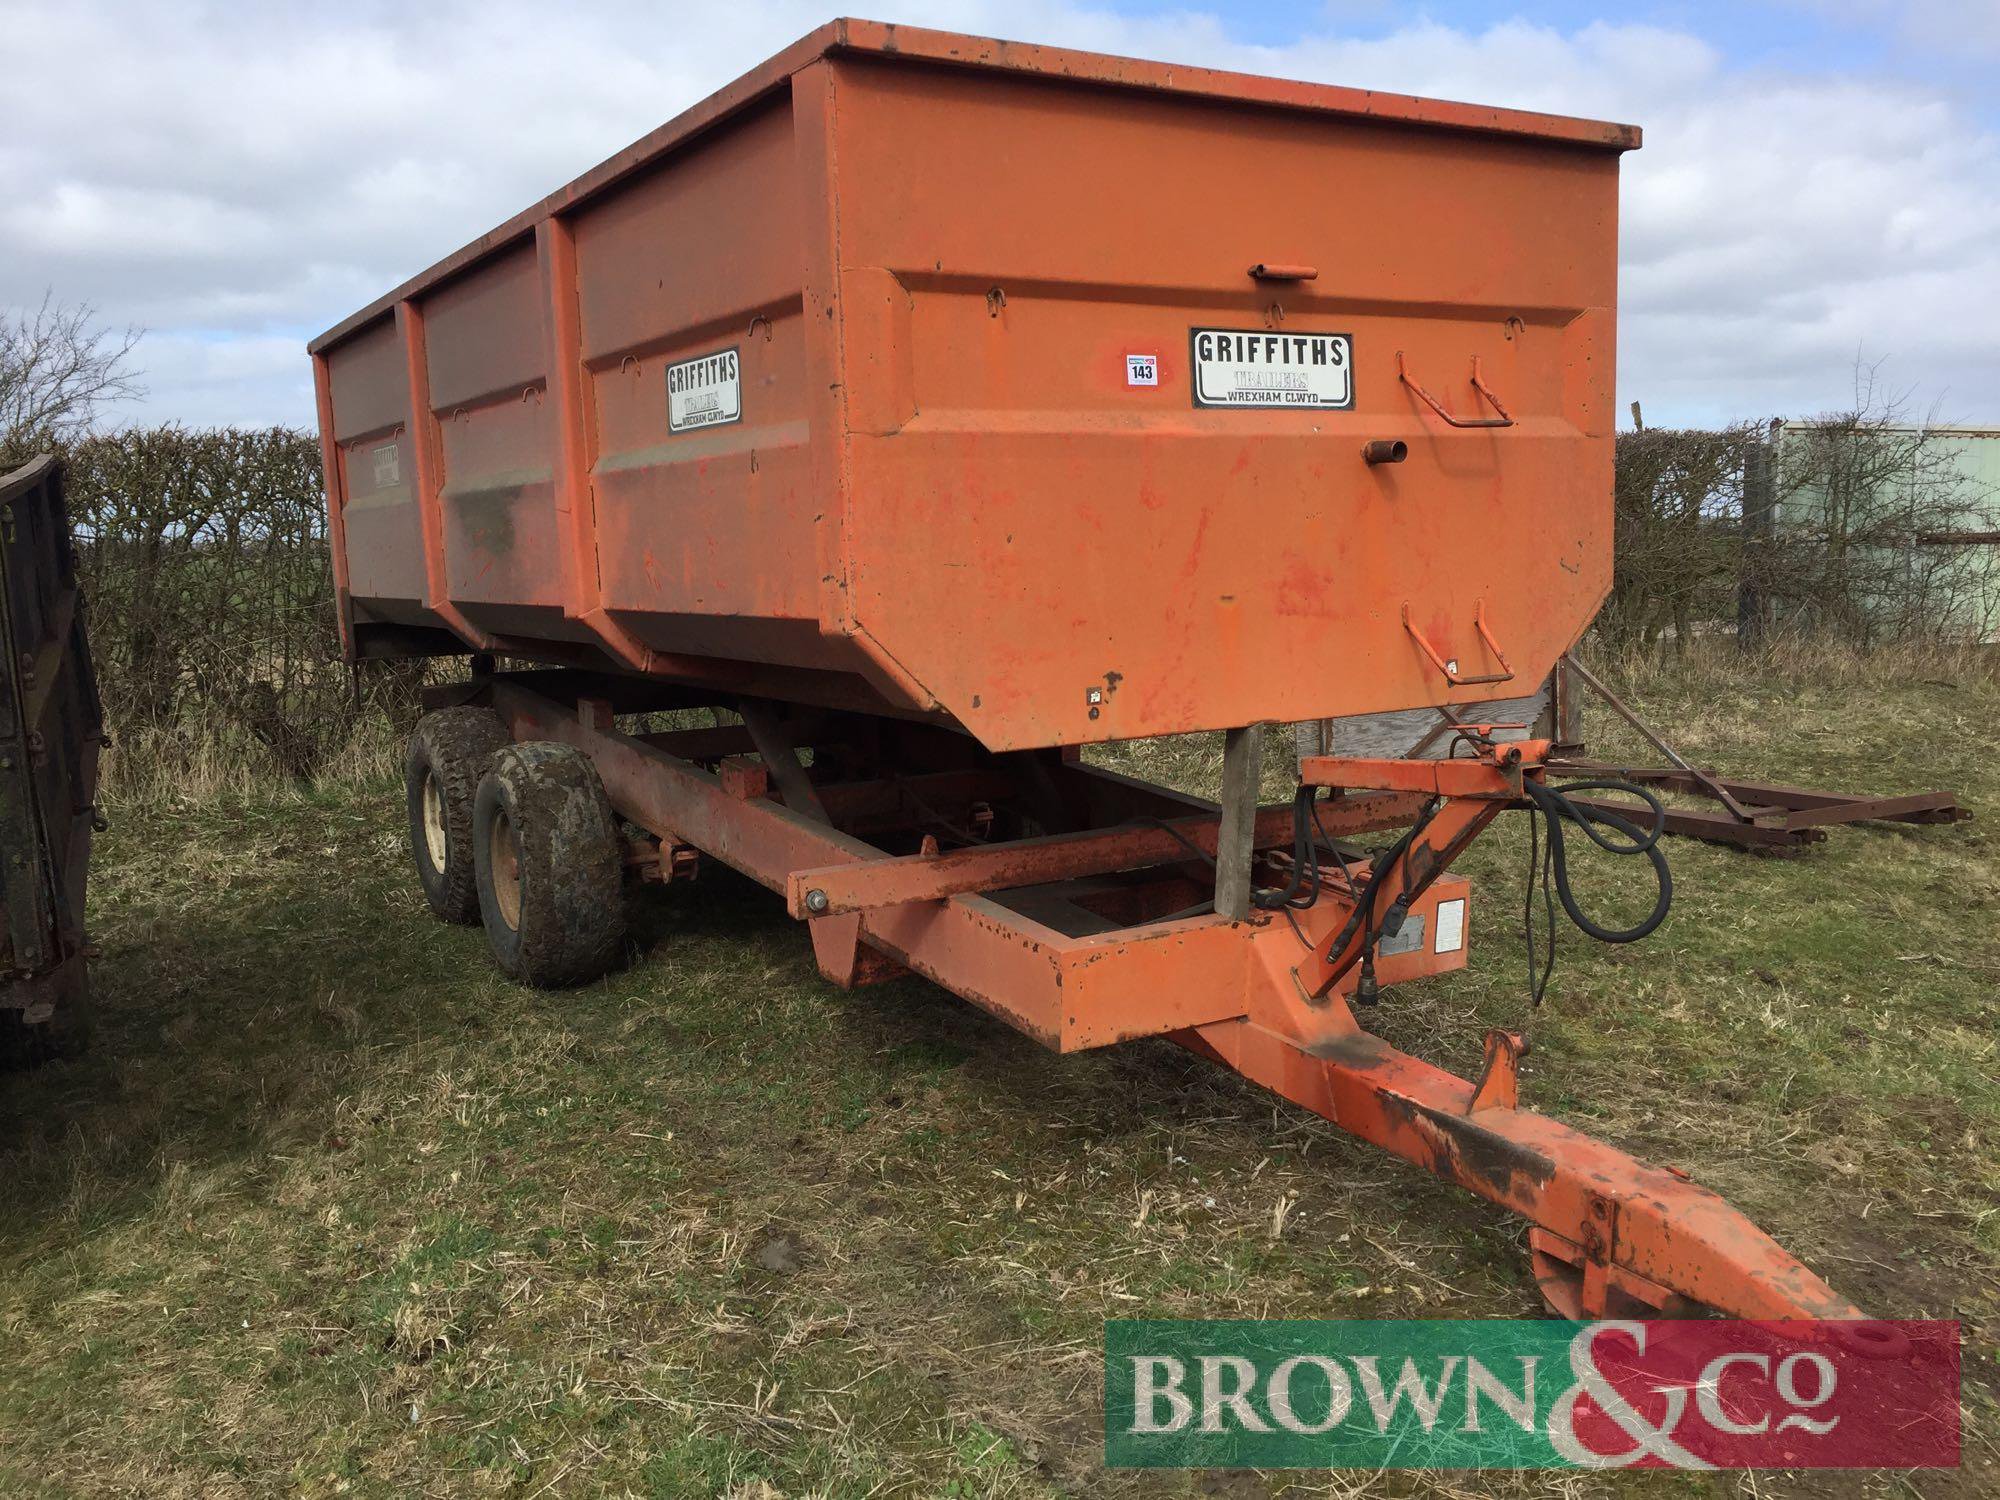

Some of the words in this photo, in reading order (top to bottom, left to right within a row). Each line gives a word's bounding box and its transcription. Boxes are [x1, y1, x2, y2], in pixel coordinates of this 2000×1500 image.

[1198, 334, 1343, 365] GRIFFITHS
[669, 353, 736, 393] GRIFFITHS
[1132, 365, 1152, 379] 143
[1235, 371, 1308, 388] TRAILERS
[1228, 392, 1281, 402] WREXHAM
[1285, 392, 1318, 403] CLWYD
